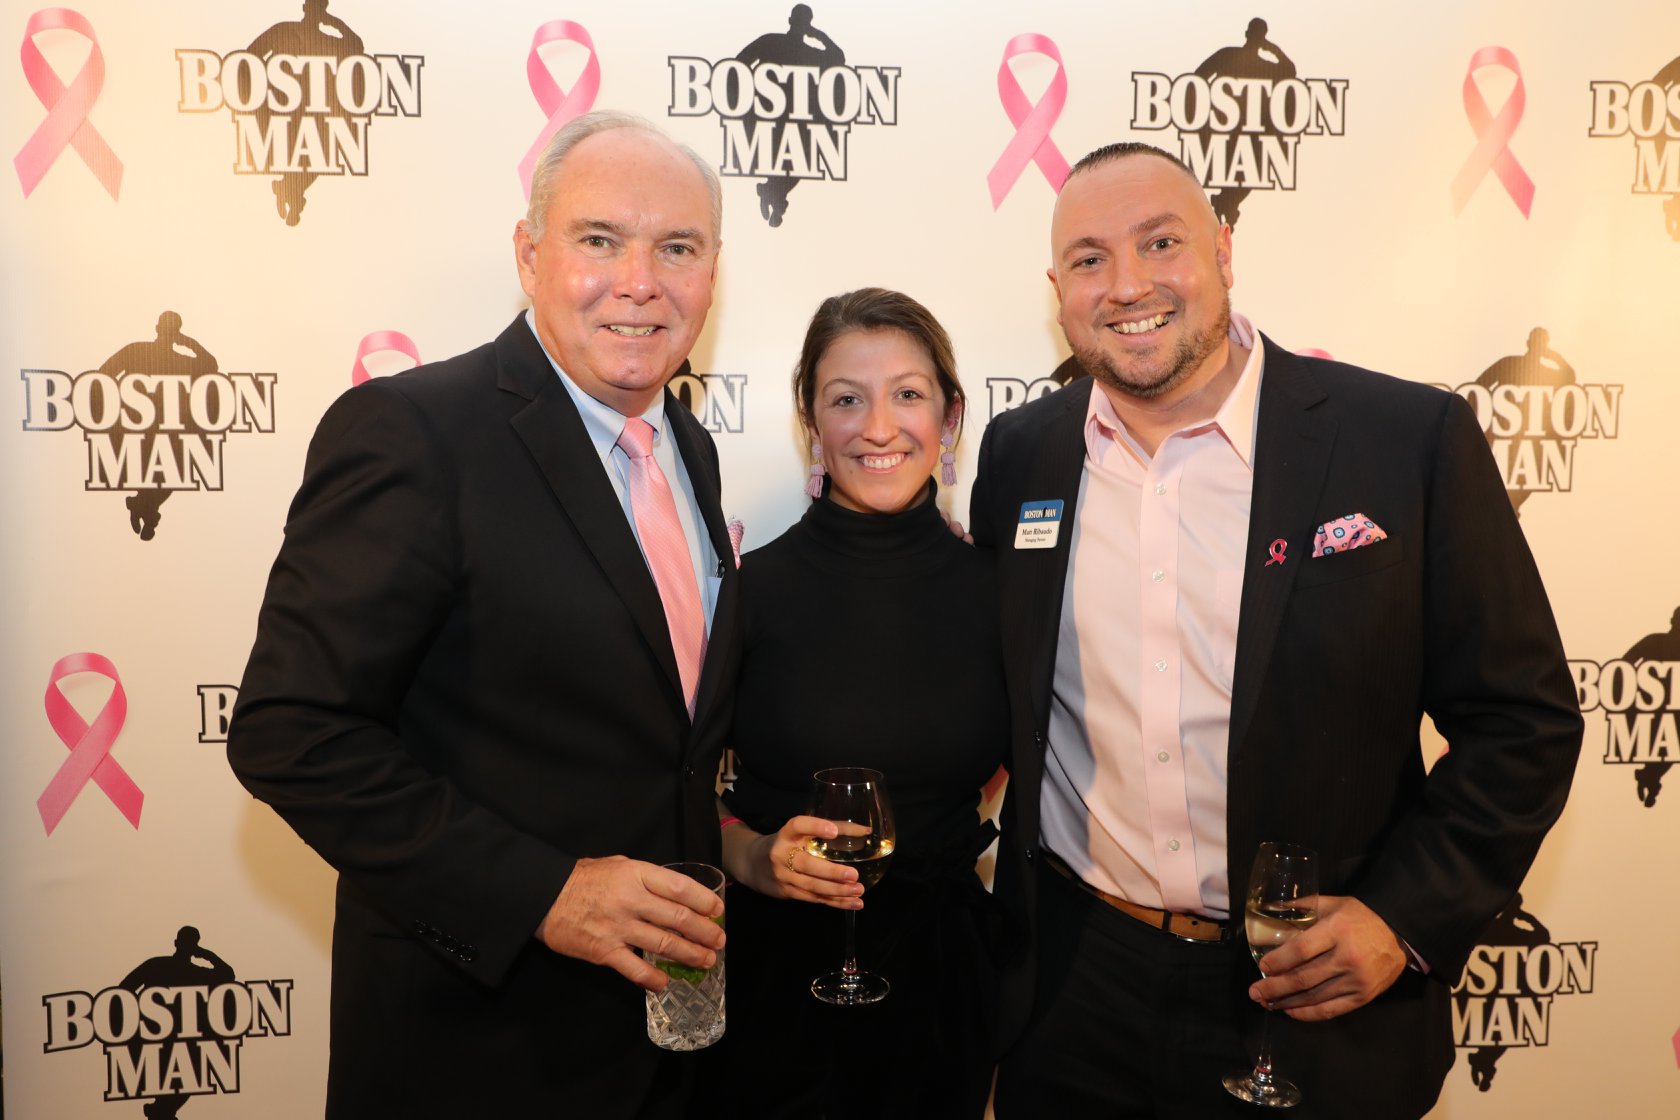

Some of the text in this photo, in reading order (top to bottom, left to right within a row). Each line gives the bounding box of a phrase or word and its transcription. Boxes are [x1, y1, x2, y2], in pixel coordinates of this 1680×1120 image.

[175, 49, 424, 117] BOSTON
[668, 56, 900, 126] BOSTON
[1130, 72, 1349, 136] BOSTON
[232, 113, 371, 176] MAN
[720, 119, 850, 181] MAN
[1178, 131, 1300, 190] MAN
[21, 369, 277, 433] BOSTON
[1426, 382, 1624, 439] OSTON
[84, 431, 226, 491] MAN
[1024, 508, 1056, 519] BOSTON MAN
[42, 979, 293, 1053] BOSTON
[104, 1037, 242, 1102] MAN
